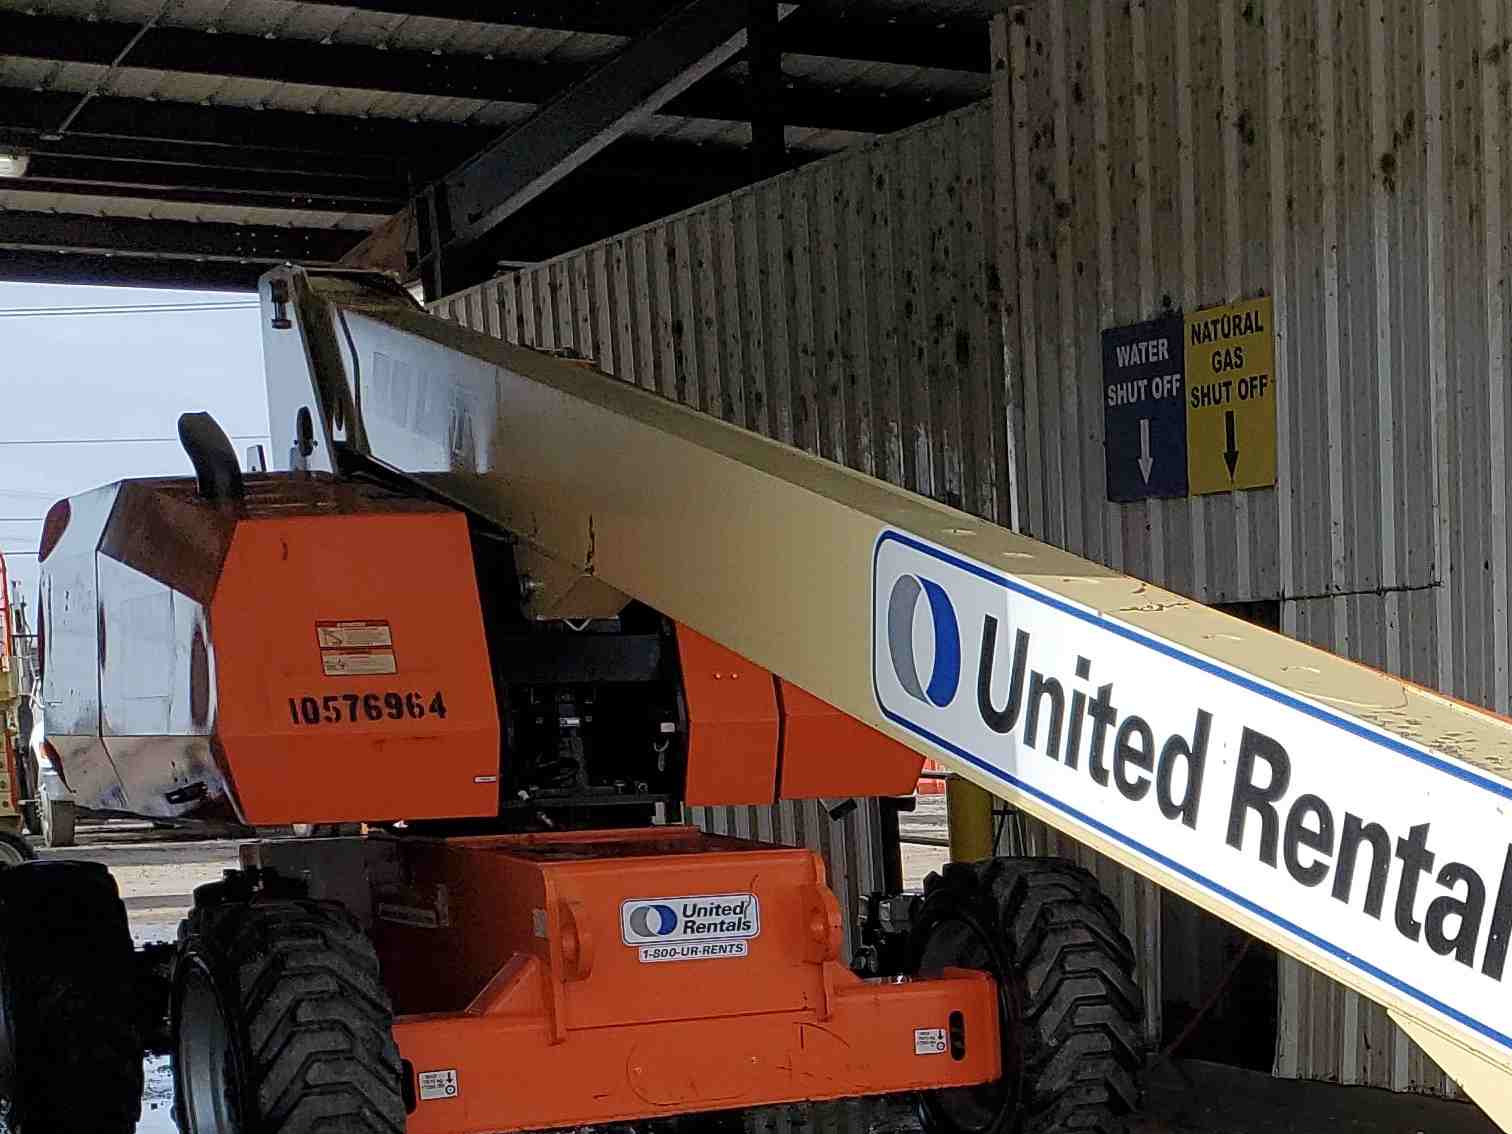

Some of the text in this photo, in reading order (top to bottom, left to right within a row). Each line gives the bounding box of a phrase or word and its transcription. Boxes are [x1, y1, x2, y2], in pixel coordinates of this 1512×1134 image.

[1191, 310, 1264, 345] NATURAL
[1116, 338, 1169, 367] WATER
[1212, 346, 1243, 373] GAS
[1107, 374, 1181, 406] SHUT OFF
[1191, 374, 1268, 408] SHUT OFF
[288, 691, 447, 724] 10576964
[976, 613, 1213, 832] United
[682, 901, 745, 918] United
[683, 917, 751, 935] Rentals
[642, 943, 744, 958] 1-800-UR-RENTS
